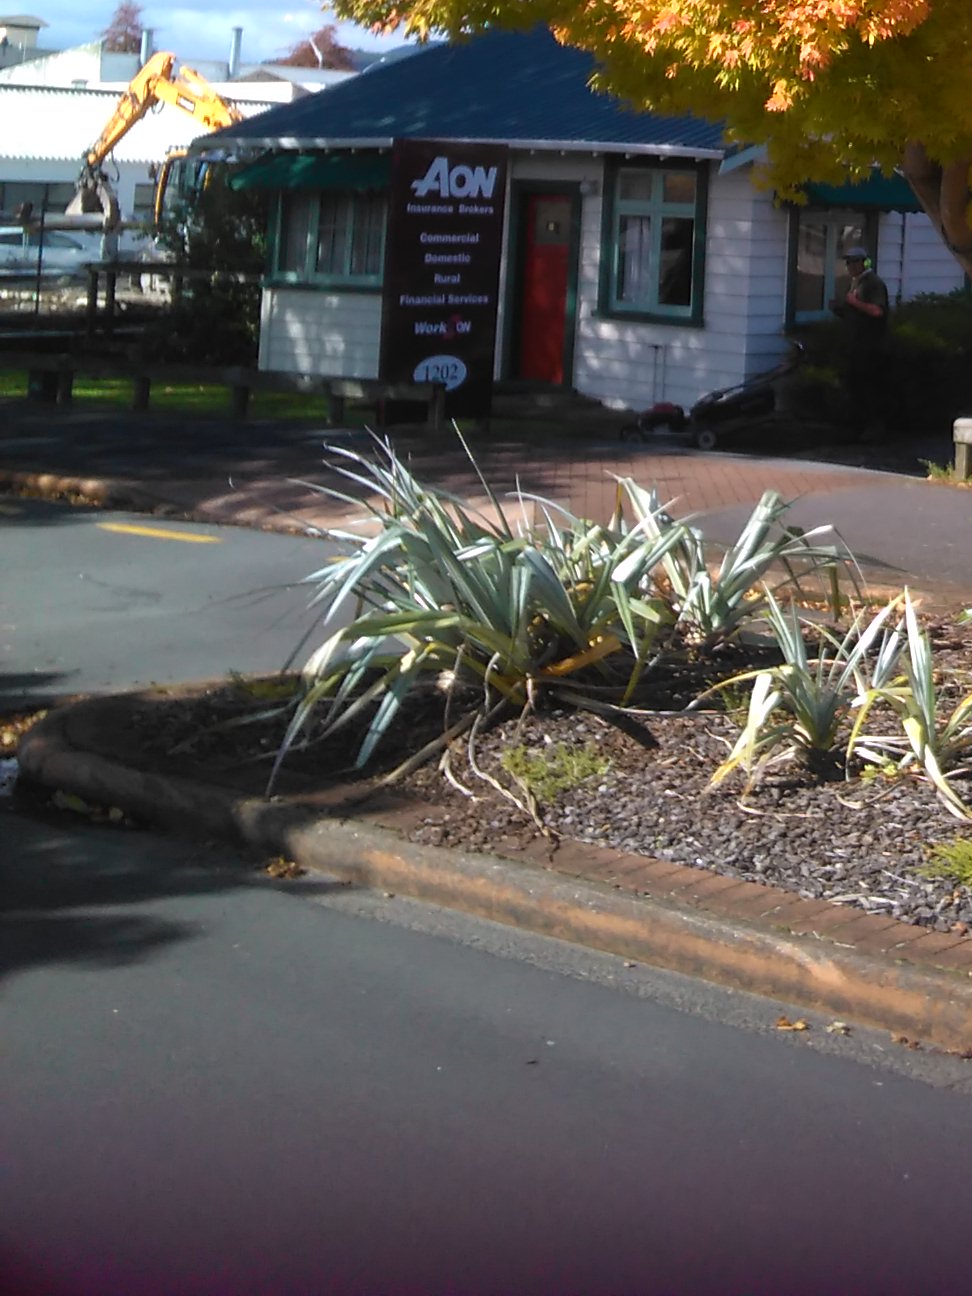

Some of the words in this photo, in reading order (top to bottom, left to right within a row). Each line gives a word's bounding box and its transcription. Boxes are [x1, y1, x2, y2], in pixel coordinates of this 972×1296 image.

[407, 203, 454, 214] Insurance
[459, 204, 494, 215] Brokers
[420, 232, 480, 244] Commercial
[424, 253, 471, 264] Domestic
[434, 273, 461, 284] Rural
[400, 293, 445, 305] Financial
[448, 293, 489, 304] Services
